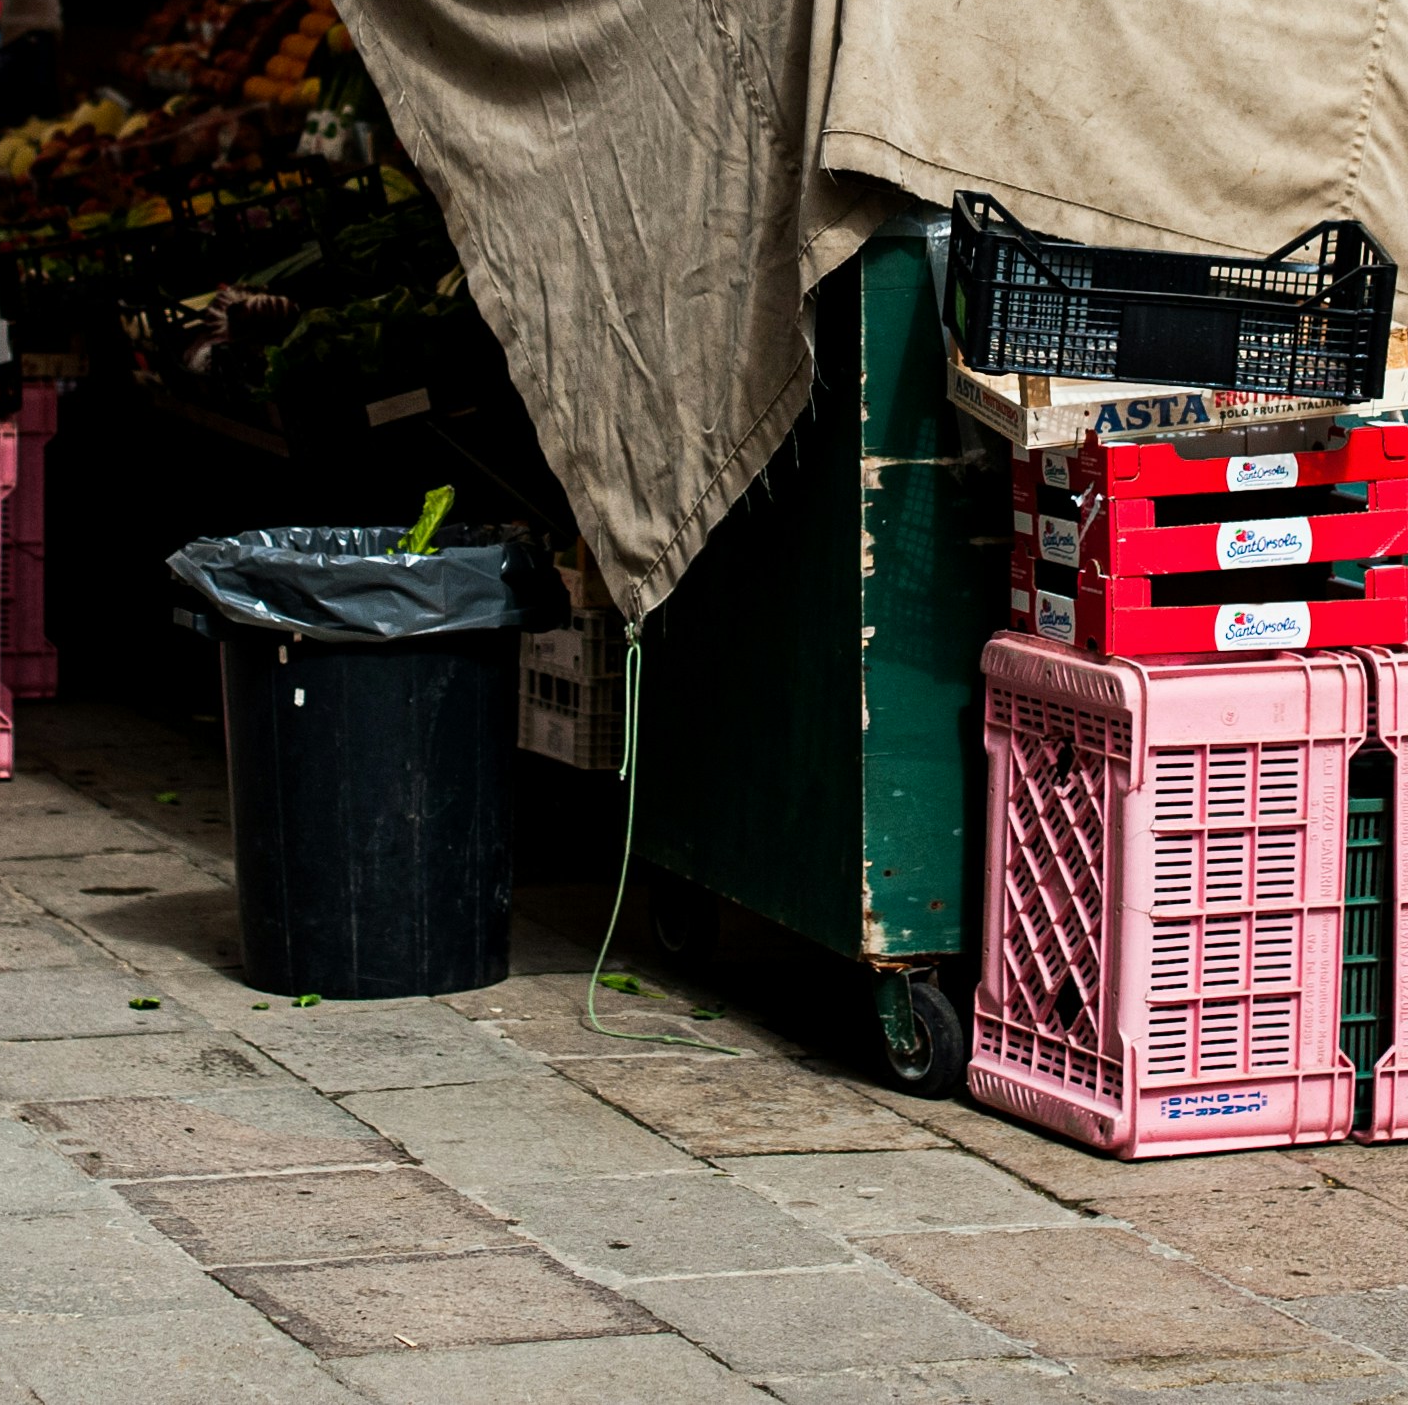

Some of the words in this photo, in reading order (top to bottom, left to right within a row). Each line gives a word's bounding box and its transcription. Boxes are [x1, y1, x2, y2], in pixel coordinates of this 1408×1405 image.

[956, 376, 982, 406] ASTA
[1094, 393, 1210, 434] ASTA
[1220, 408, 1248, 420] SOLO
[1253, 403, 1294, 415] FRUTTA
[1168, 1103, 1261, 1119] CANARIN
